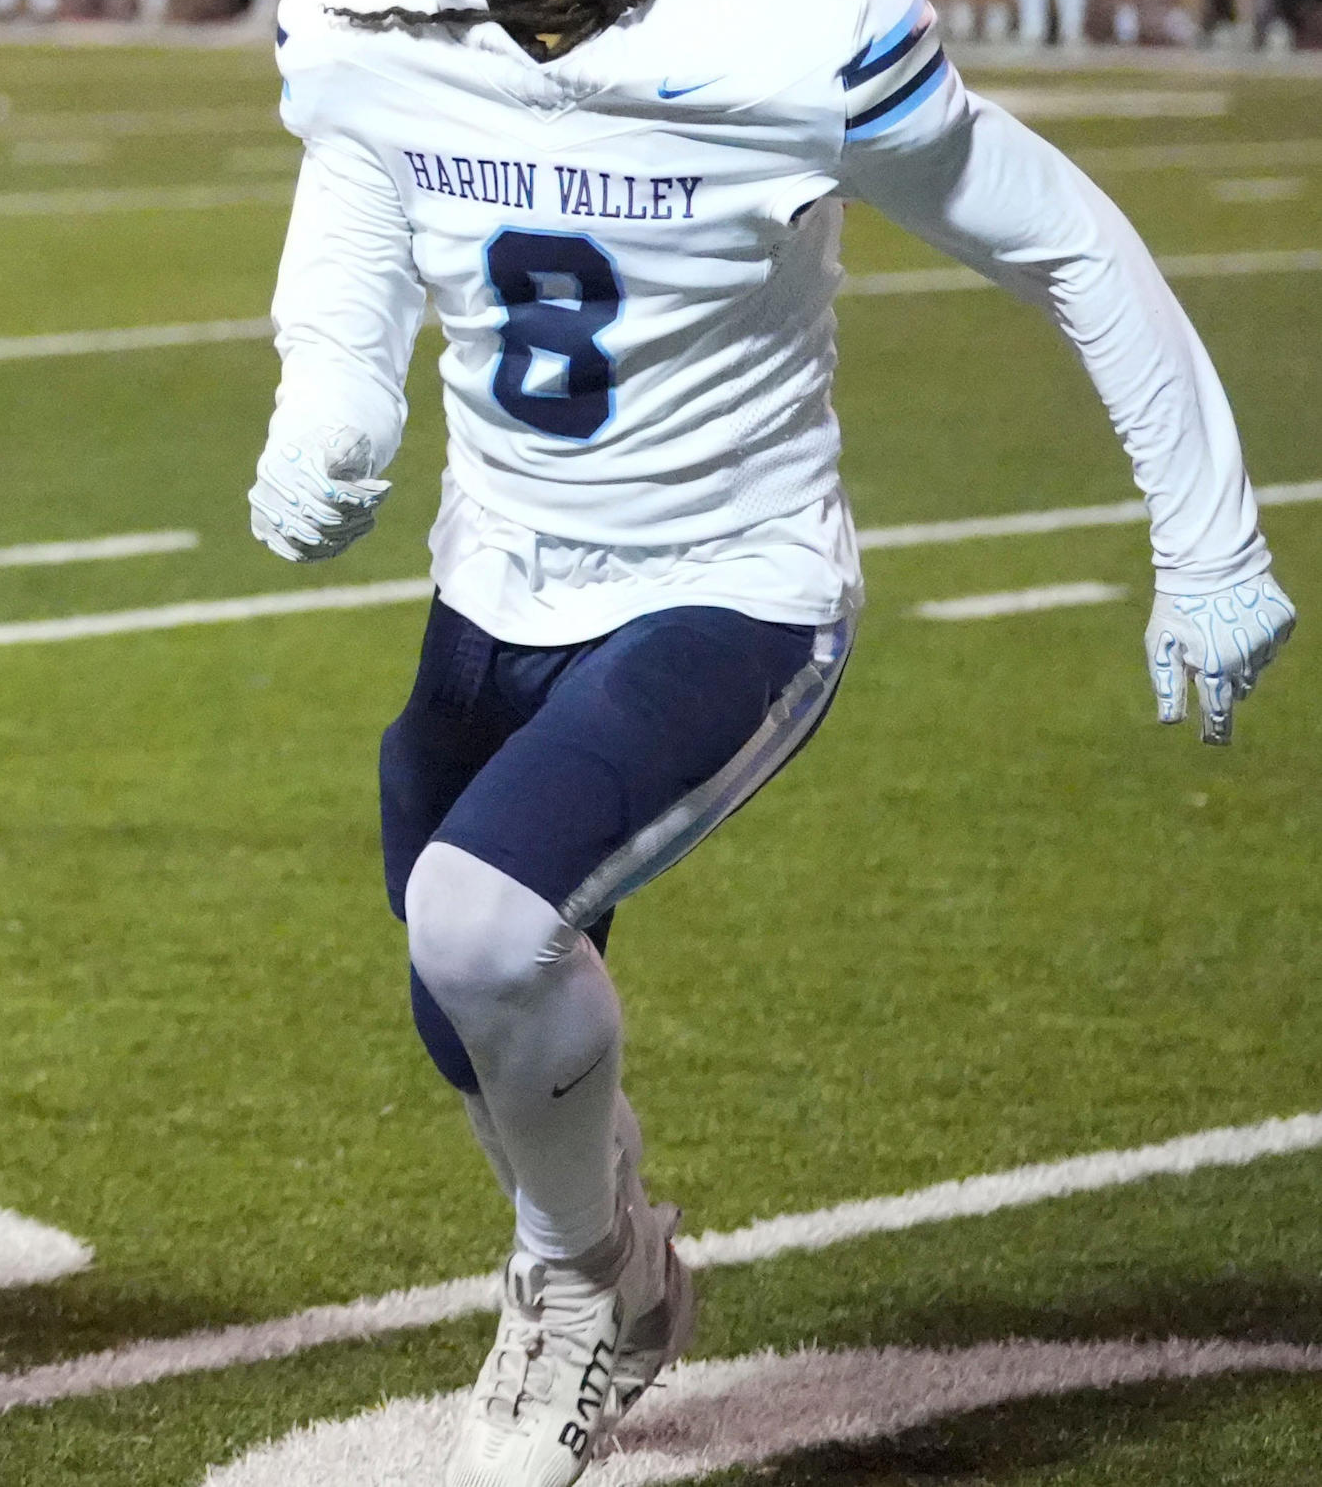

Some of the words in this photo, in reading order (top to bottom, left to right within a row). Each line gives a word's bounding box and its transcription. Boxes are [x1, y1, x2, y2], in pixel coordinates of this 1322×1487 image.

[404, 150, 537, 210] HARDIN
[554, 164, 703, 220] VALLEY
[480, 224, 626, 445] 8
